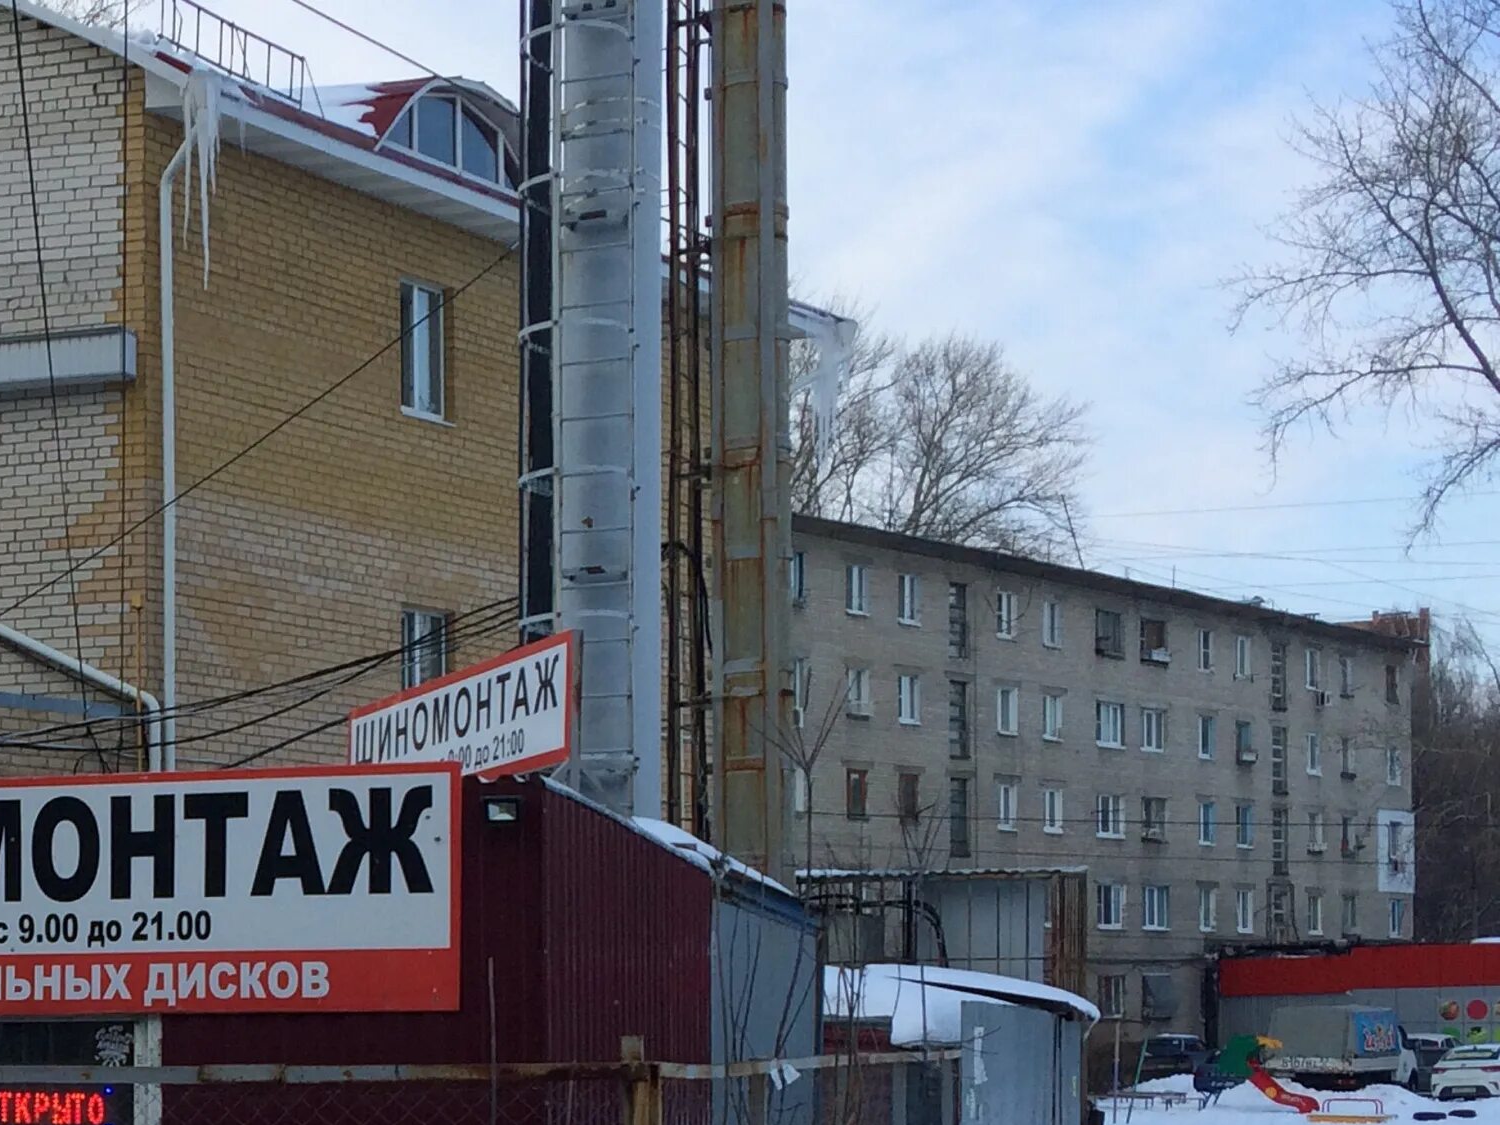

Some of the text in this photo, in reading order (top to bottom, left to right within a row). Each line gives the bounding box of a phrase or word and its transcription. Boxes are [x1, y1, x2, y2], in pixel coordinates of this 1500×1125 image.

[355, 654, 559, 763] ШИНОМОНТАЖ
[475, 745, 490, 769] до
[493, 728, 525, 760] 21:00
[18, 914, 79, 945] 9.00
[87, 919, 124, 947] до
[131, 911, 212, 943] 21.00
[143, 961, 331, 1007] ДИСКОВ
